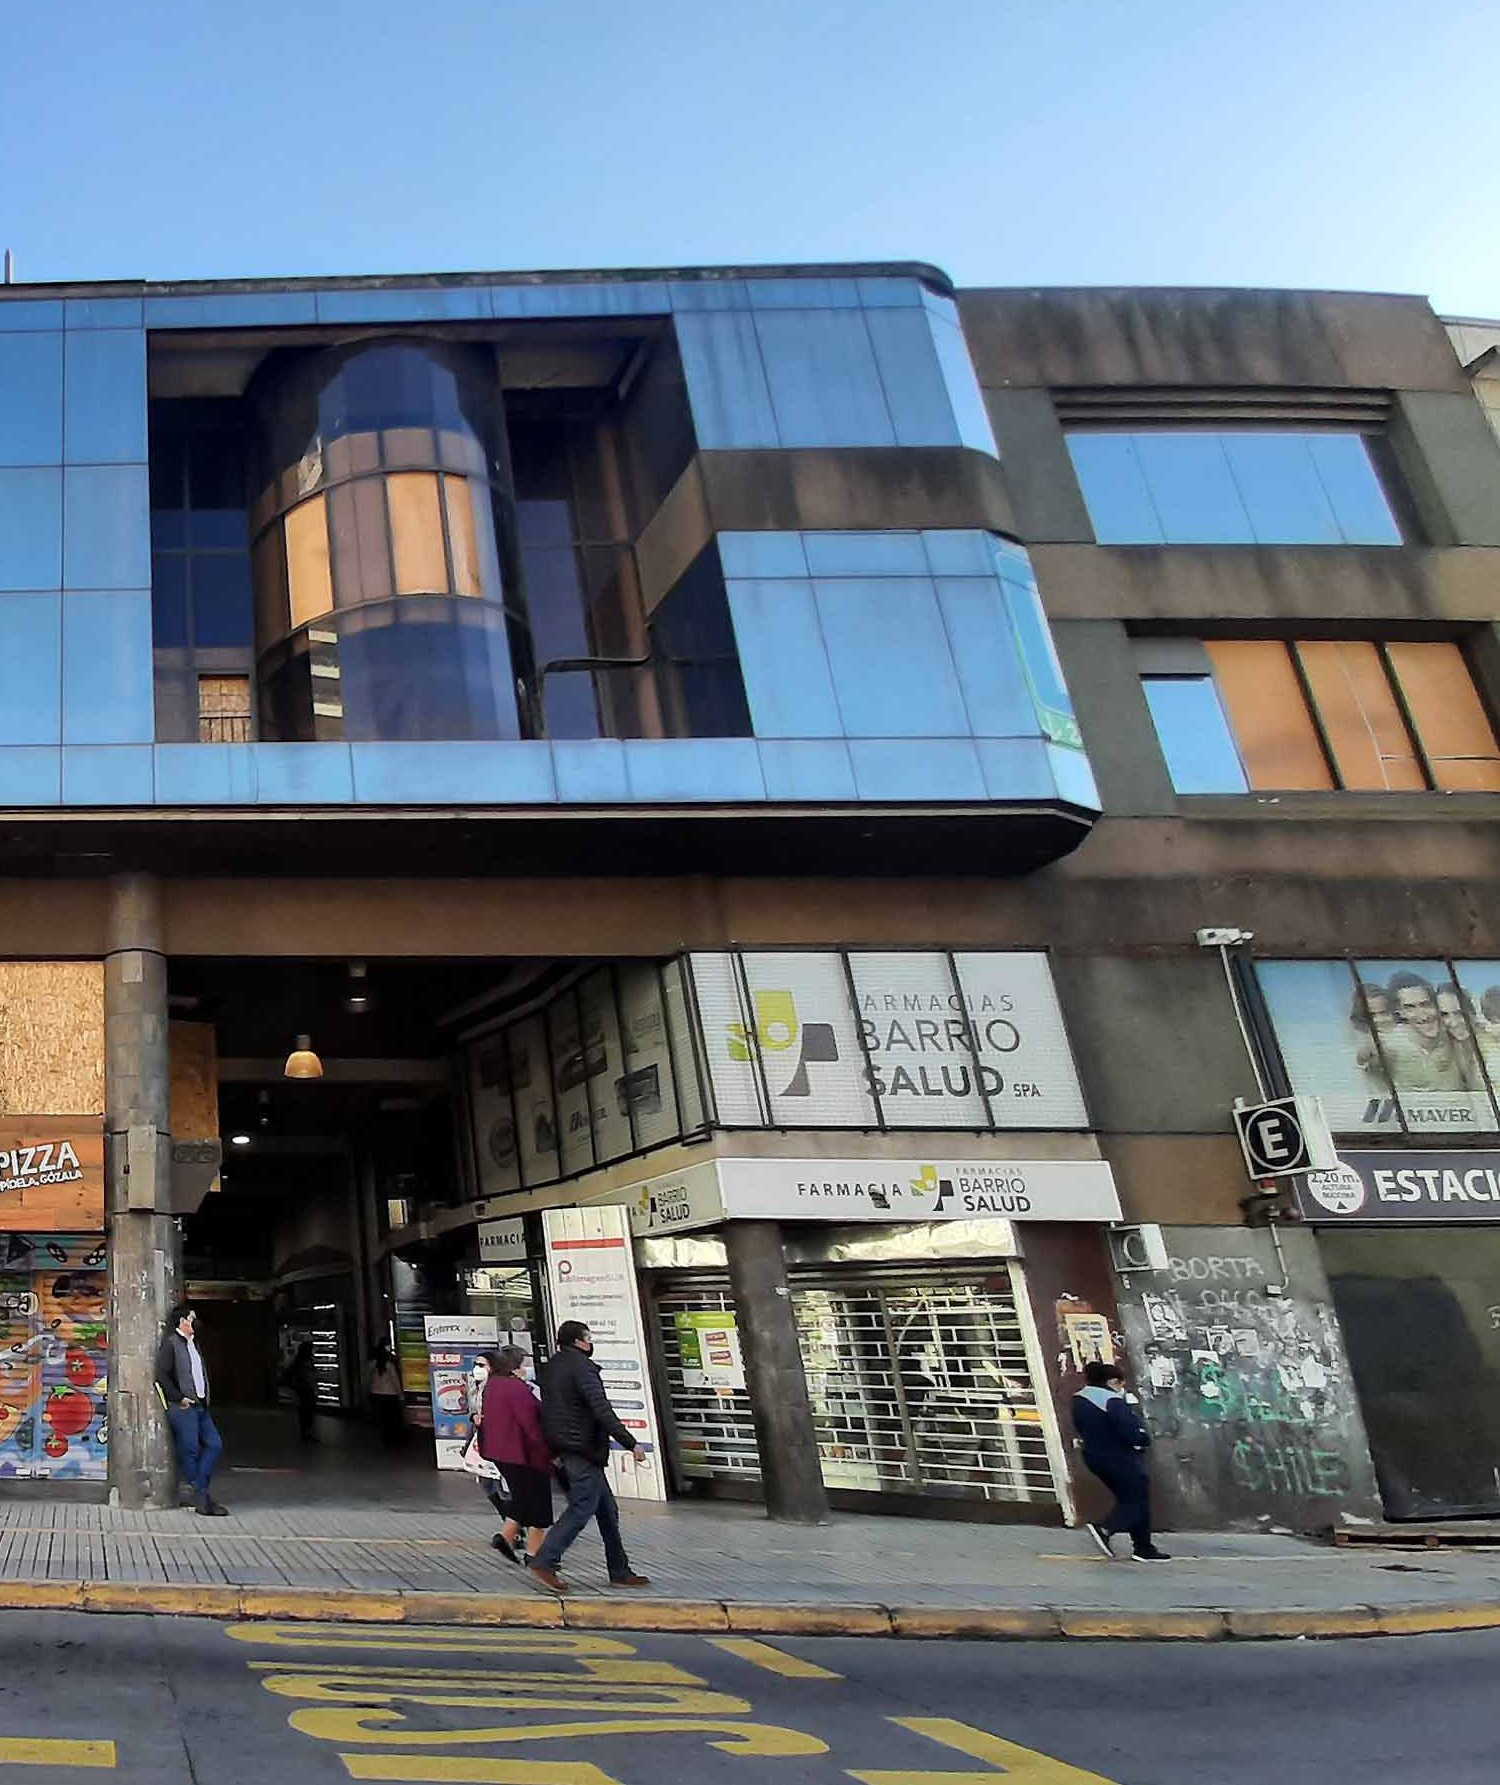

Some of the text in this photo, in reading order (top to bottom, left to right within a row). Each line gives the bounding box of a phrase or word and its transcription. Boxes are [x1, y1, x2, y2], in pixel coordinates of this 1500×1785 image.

[851, 994, 1014, 1012] ARMACIAS
[857, 1019, 1020, 1052] BARRIO
[863, 1065, 1004, 1097] SALUD
[1257, 1118, 1289, 1160] E
[959, 1178, 1026, 1194] BARRIO
[660, 1203, 690, 1223] SALUD
[965, 1195, 1031, 1212] SALUD
